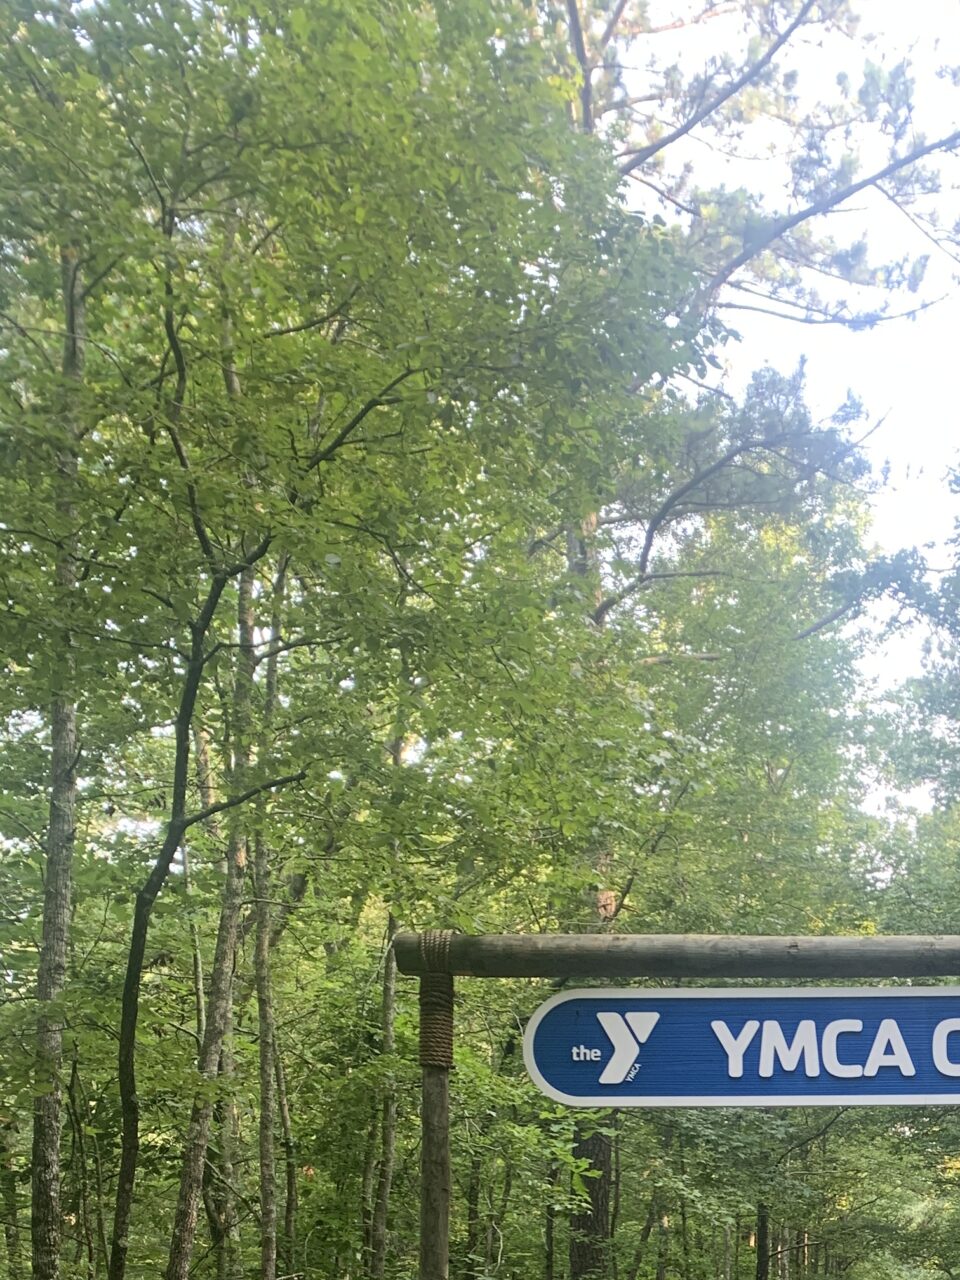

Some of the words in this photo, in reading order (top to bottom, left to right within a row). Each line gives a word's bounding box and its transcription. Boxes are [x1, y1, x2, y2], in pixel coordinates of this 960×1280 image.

[571, 1044, 602, 1061] the
[596, 1011, 661, 1085] Y
[624, 1062, 642, 1083] YMCA
[710, 1018, 916, 1078] YMCA
